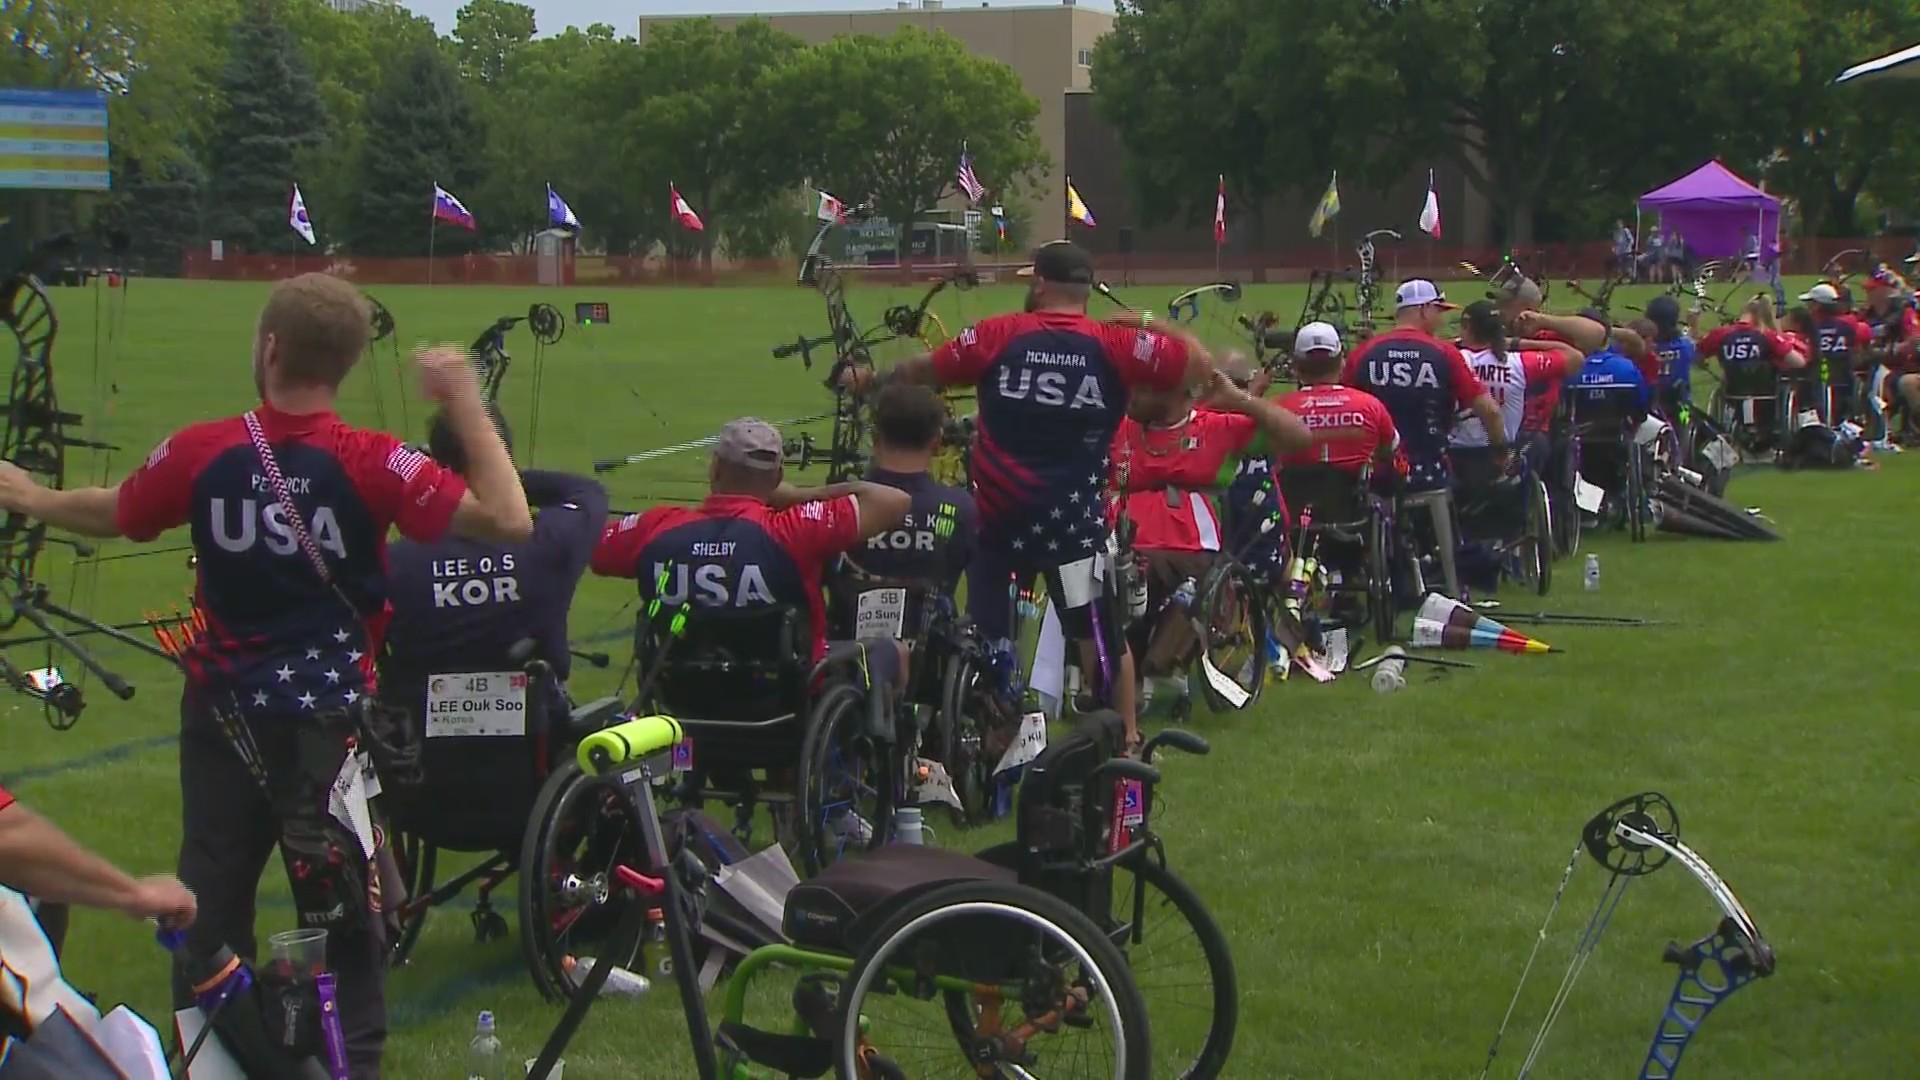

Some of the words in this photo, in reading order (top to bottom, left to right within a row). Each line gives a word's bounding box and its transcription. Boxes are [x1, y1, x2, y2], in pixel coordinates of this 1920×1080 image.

[1723, 344, 1760, 359] USA
[1820, 336, 1848, 351] SA
[1026, 350, 1086, 367] MCNAMARA
[1369, 361, 1439, 388] USA
[999, 365, 1106, 409] USA
[210, 498, 347, 559] USA
[692, 542, 736, 556] SHELBY
[867, 531, 935, 551] KOR
[433, 576, 521, 607] KOR
[654, 562, 776, 607] USA
[465, 678, 488, 692] 4B
[430, 701, 458, 713] LEE
[463, 699, 490, 712] Ouk
[496, 699, 523, 711] Soo
